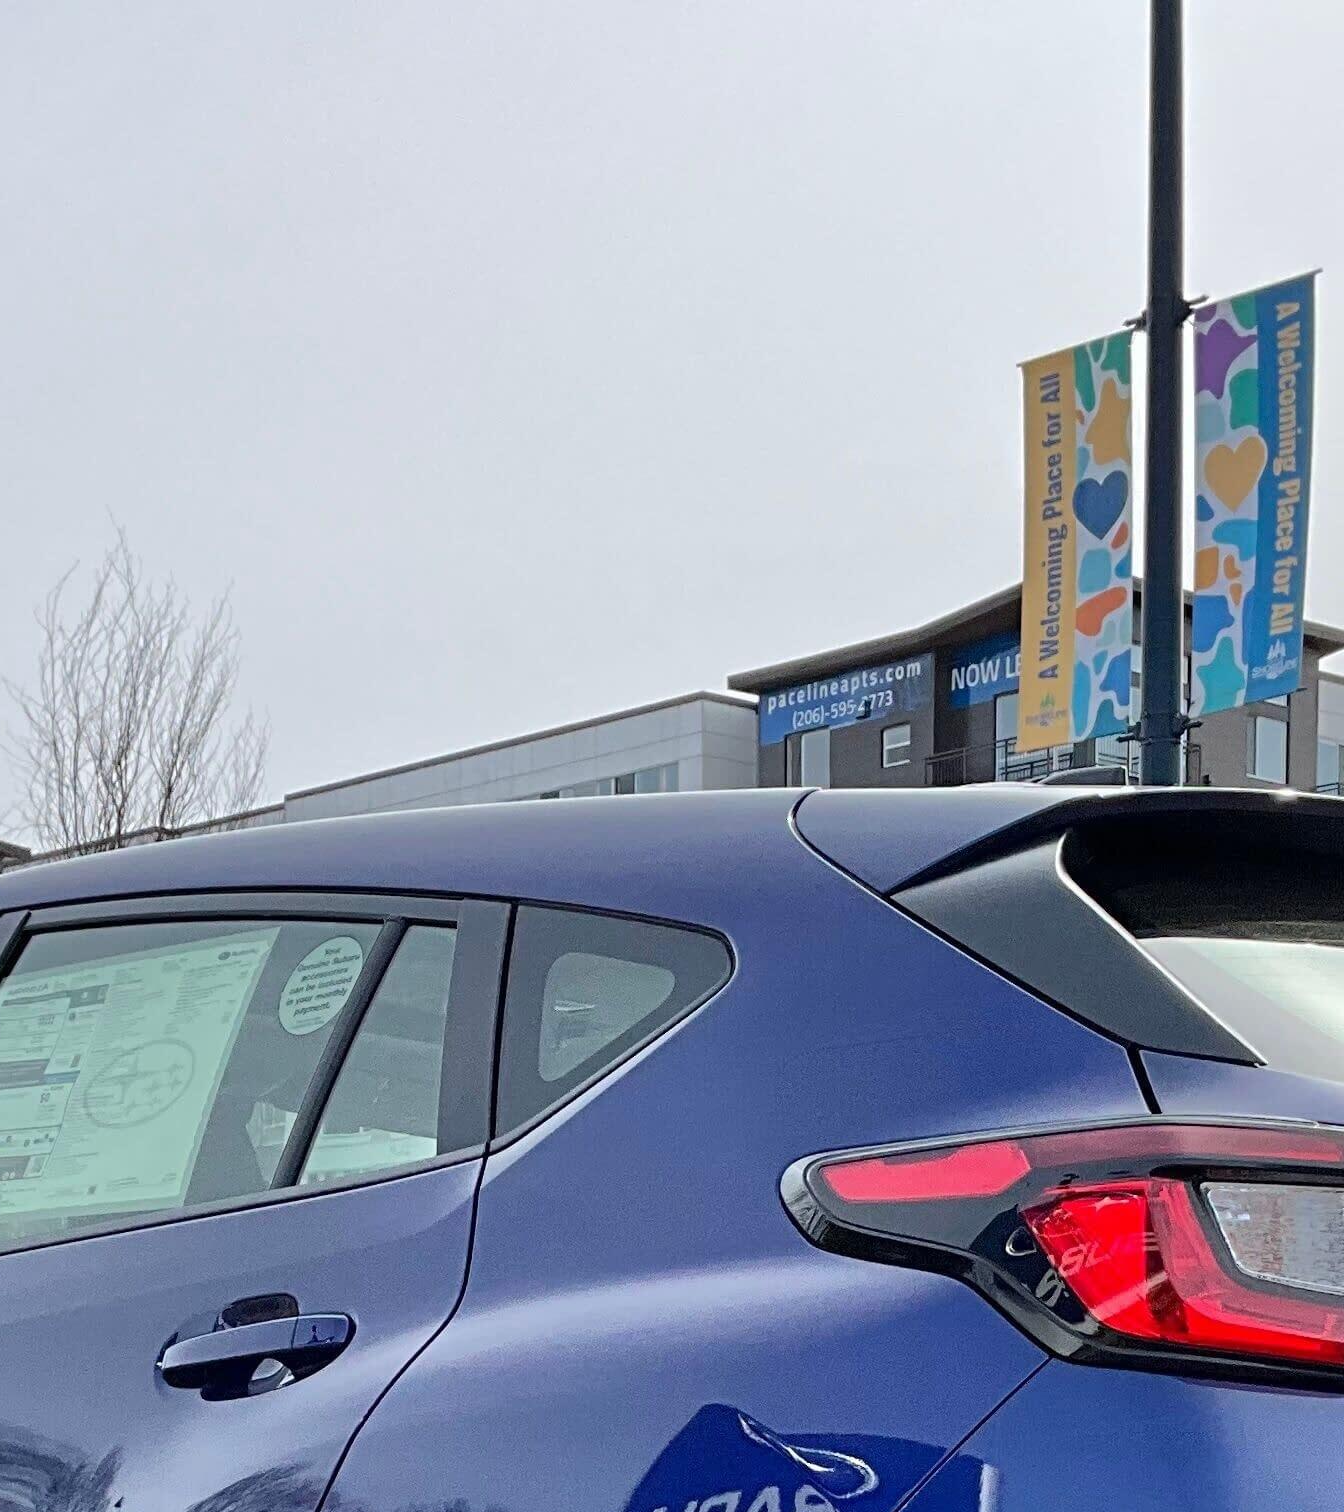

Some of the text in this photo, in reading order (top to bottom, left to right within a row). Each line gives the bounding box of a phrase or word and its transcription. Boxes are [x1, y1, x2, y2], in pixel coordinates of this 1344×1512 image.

[1038, 372, 1068, 679] A Welcoming Place for All
[1269, 302, 1302, 636] A Welcoming Place for All
[766, 659, 922, 714] pacelineapts.com
[950, 659, 1001, 691] NOW
